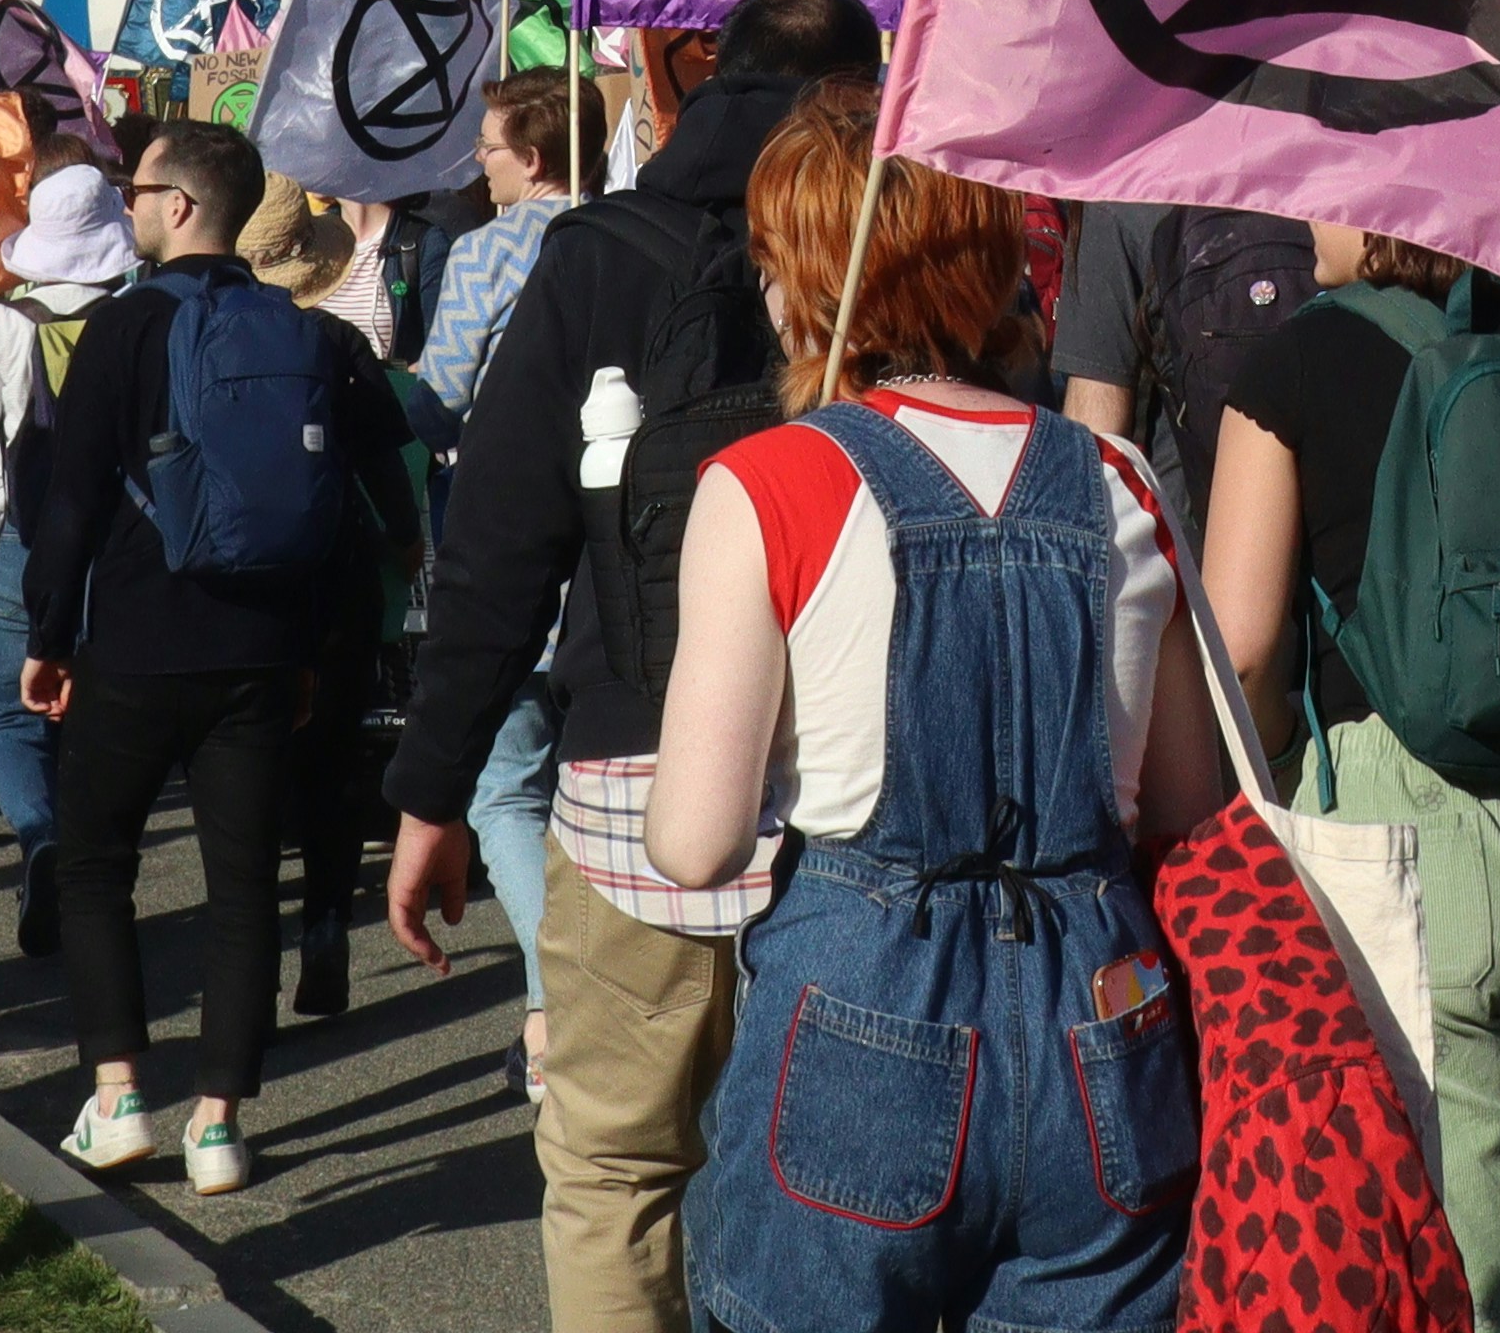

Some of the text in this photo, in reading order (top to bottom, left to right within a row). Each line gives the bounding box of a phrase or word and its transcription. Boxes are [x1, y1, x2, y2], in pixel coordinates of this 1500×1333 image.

[194, 51, 262, 71] NO NEW
[206, 68, 260, 86] FOSSIL
